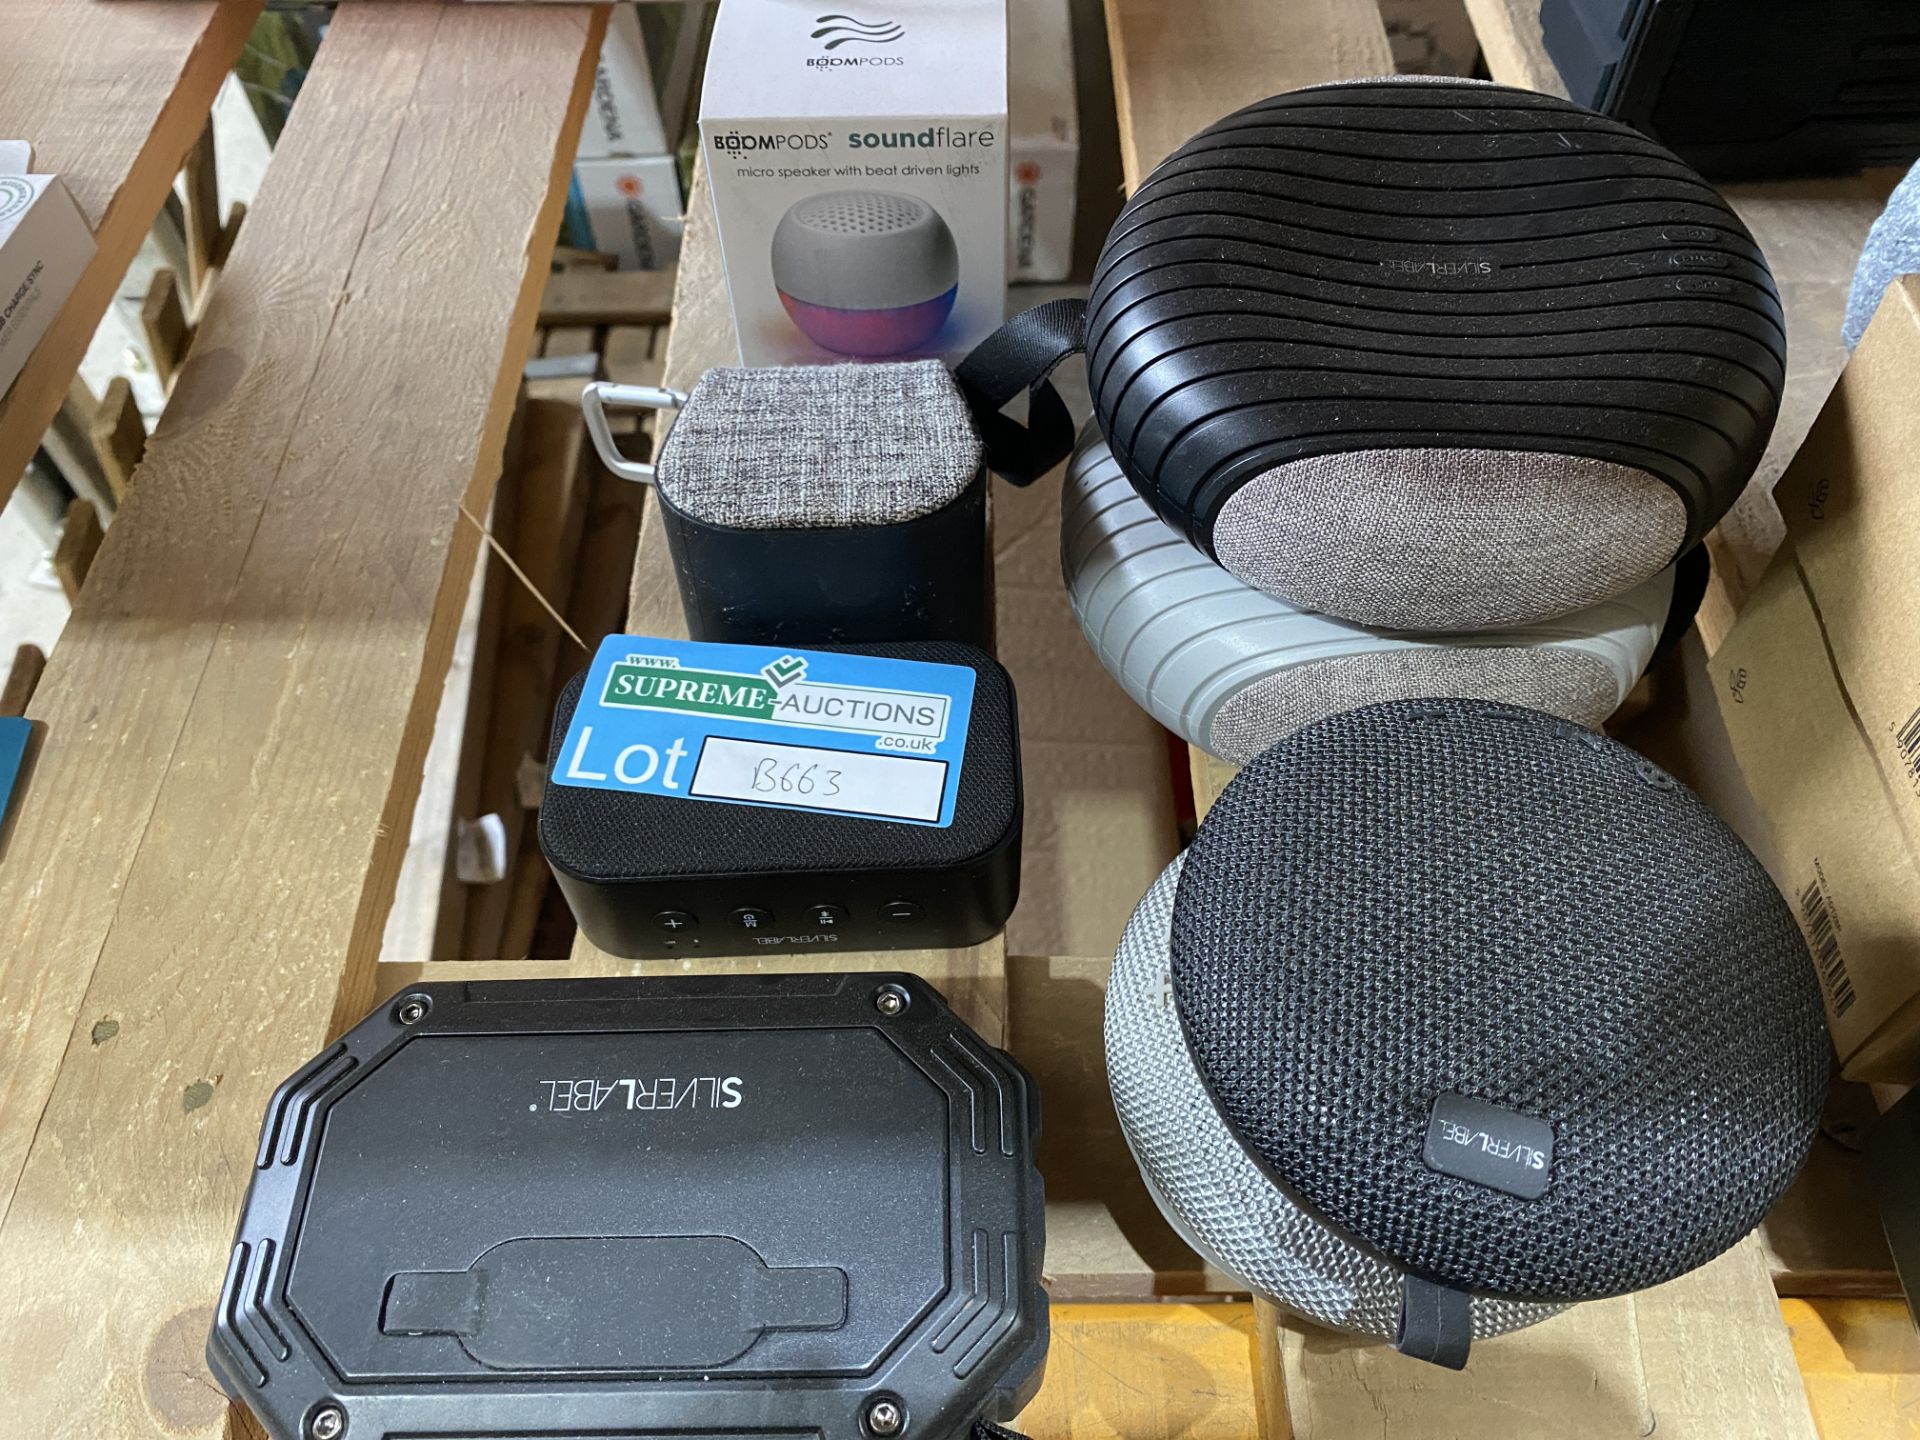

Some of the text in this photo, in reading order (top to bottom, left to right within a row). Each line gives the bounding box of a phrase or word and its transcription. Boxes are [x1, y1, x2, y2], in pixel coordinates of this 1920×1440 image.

[848, 127, 994, 148] soundflare
[737, 164, 980, 179] micro speaker with beat driven lights
[25, 260, 44, 284] SYNC
[1386, 260, 1492, 275] SILVERLABEL
[629, 656, 676, 668] www.
[878, 735, 933, 750] .co.uk
[567, 726, 688, 790] Lot
[752, 758, 842, 796] B663
[752, 934, 839, 945] SILVERLABEL
[540, 1077, 743, 1111] SILVERLABEL
[1438, 1119, 1545, 1170] SILVERLABEL
